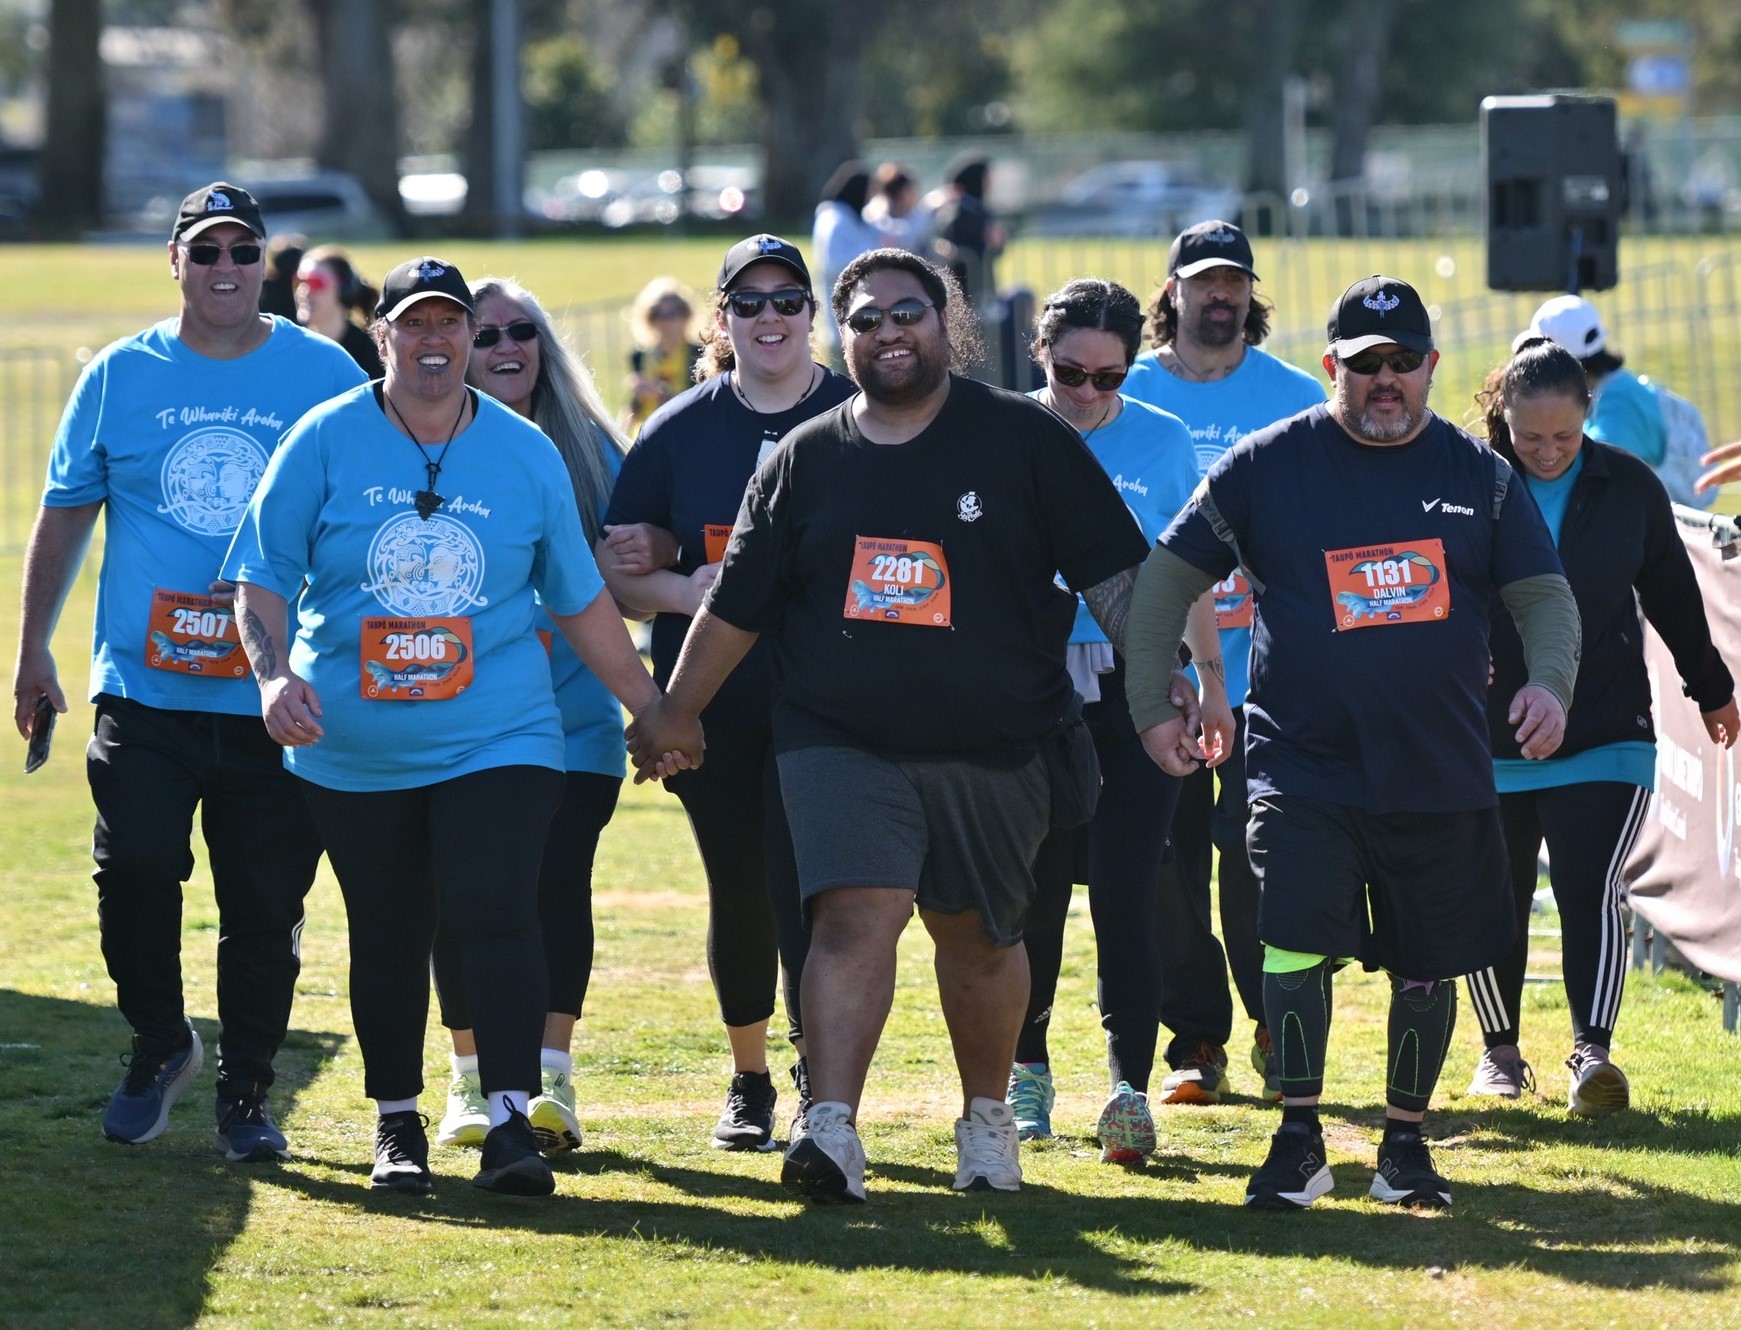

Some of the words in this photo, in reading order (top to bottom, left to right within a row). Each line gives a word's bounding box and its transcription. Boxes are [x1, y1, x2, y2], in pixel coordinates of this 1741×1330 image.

[156, 408, 175, 429] Te
[180, 406, 239, 426] Whariki
[240, 408, 283, 430] Aroha
[363, 486, 384, 507] Te
[447, 496, 491, 518] Aroha
[1441, 502, 1474, 516] Tenon
[877, 543, 908, 553] MARATHON
[1355, 547, 1394, 559] MARATHON
[872, 555, 923, 584] 2281
[1361, 559, 1412, 587] 1131
[883, 584, 904, 596] KOLI
[1373, 586, 1406, 600] DALVIN
[176, 596, 213, 607] MARATHON
[873, 594, 885, 602] HALF
[885, 596, 915, 605] MARATHON
[1369, 599, 1382, 607] HALF
[1383, 597, 1414, 606] MARATHON
[172, 608, 229, 638] 2507
[388, 621, 426, 630] MARATHON
[176, 646, 188, 655] HALF
[189, 649, 218, 658] MARATHON
[386, 634, 446, 660] 2506
[394, 673, 407, 681] HALF
[407, 673, 438, 681] MARATHON
